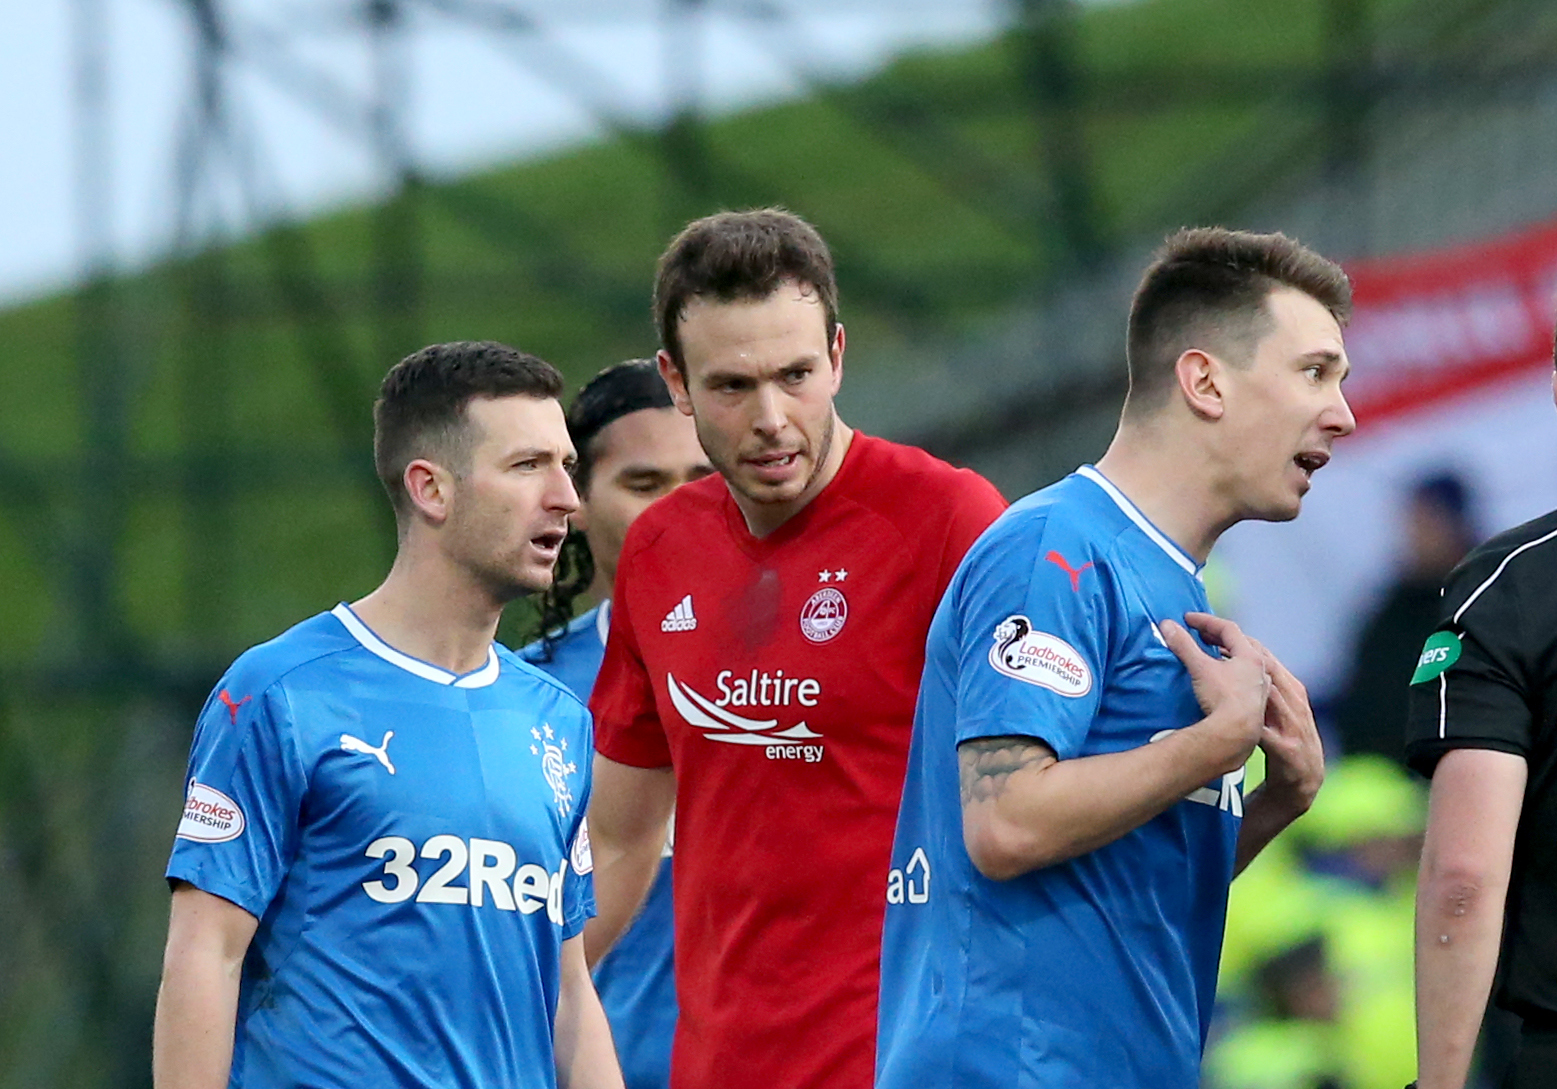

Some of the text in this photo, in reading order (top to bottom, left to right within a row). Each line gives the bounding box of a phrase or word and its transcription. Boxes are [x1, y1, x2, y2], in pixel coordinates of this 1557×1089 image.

[661, 618, 698, 633] adidas
[1017, 655, 1082, 687] PREMIERSHIP
[1019, 640, 1086, 679] Ladbrokes
[715, 668, 821, 707] Saltire
[765, 744, 824, 763] energy
[362, 833, 568, 927] 32Red
